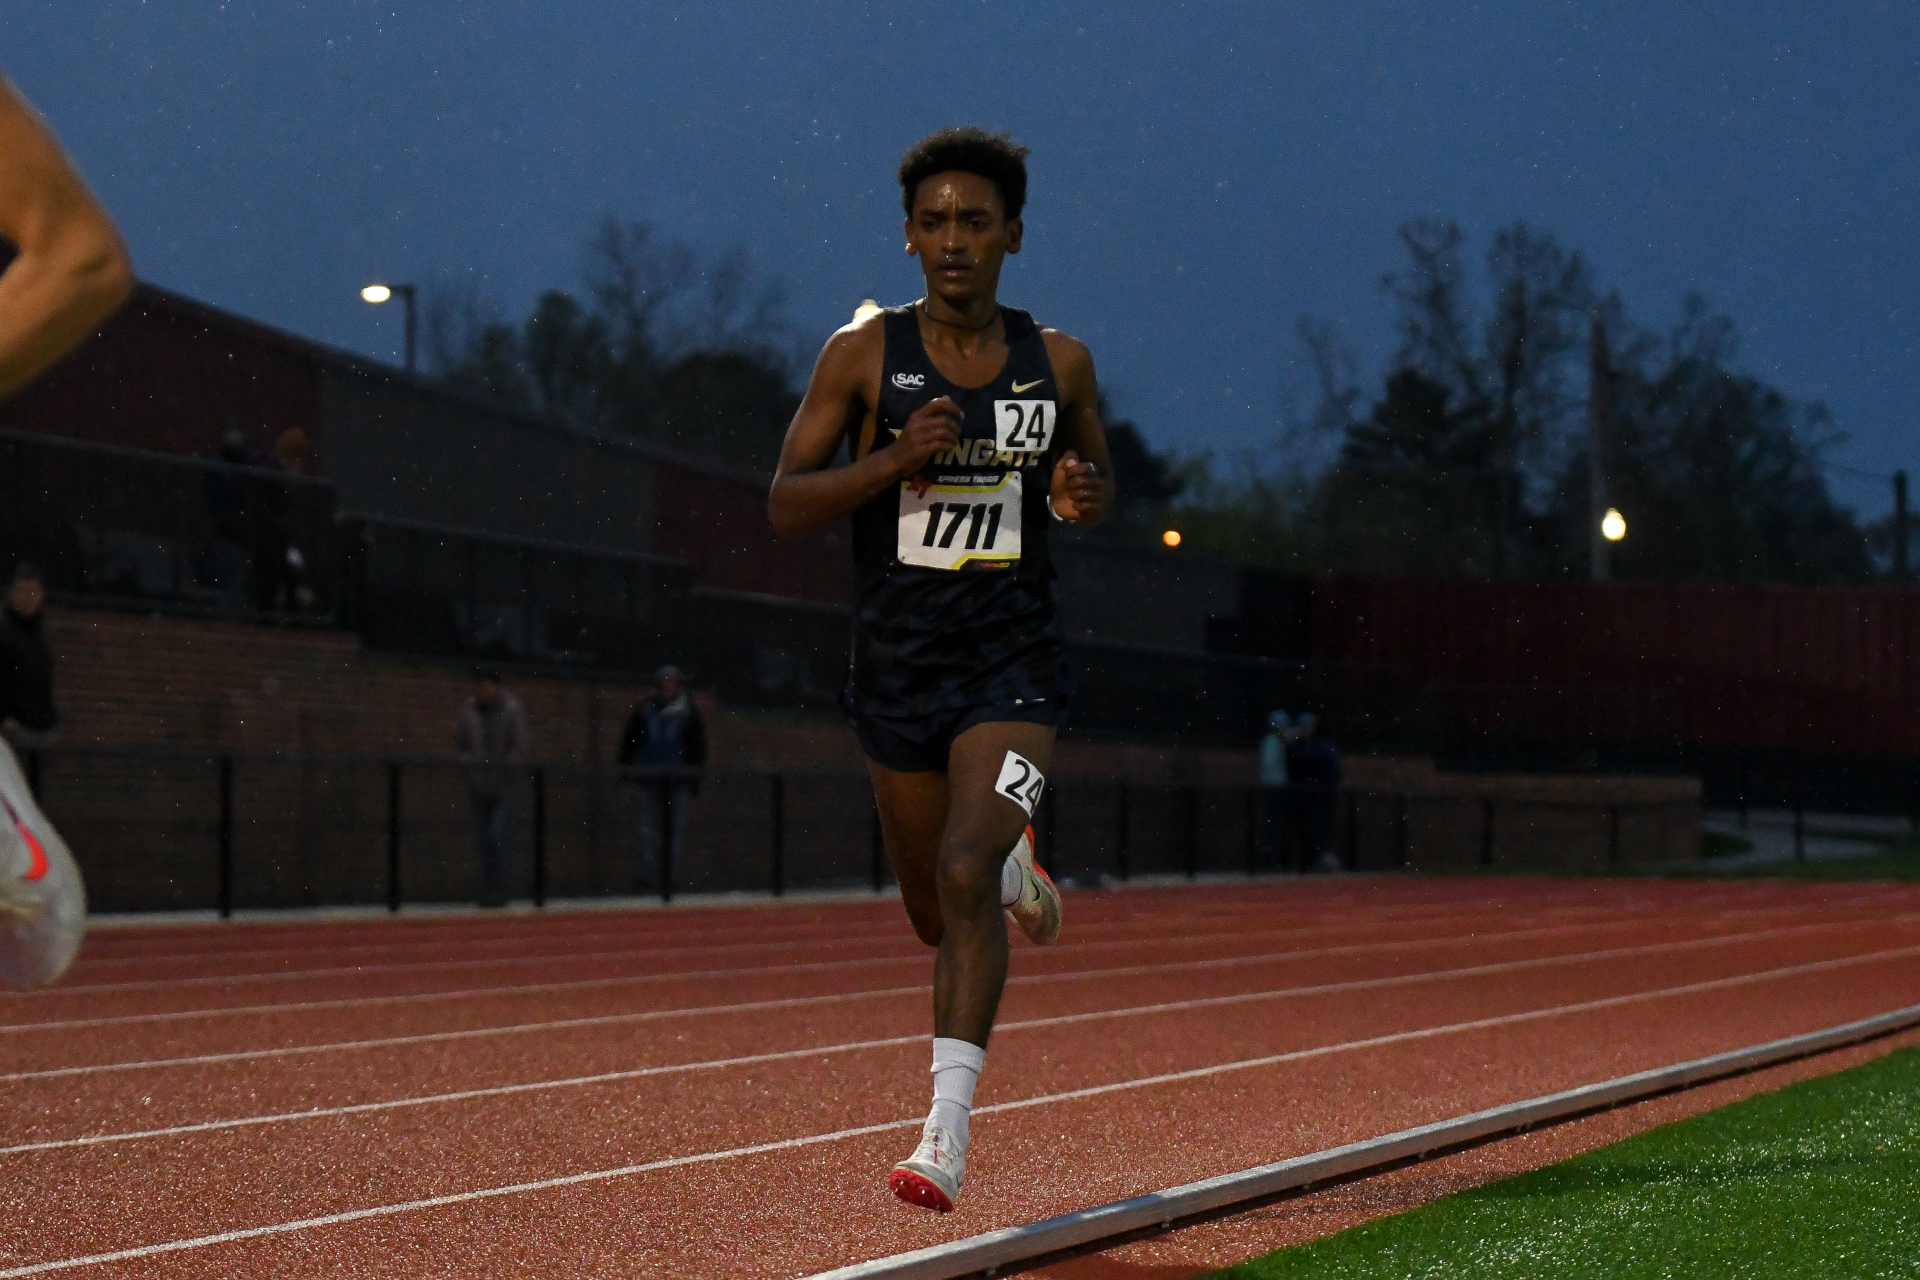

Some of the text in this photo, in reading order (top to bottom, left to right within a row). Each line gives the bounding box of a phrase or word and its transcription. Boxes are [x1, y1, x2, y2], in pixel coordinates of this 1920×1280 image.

[896, 373, 925, 385] SAC
[888, 428, 1043, 467] INGAE
[1005, 403, 1046, 448] 24
[922, 502, 1003, 549] 1711
[1004, 759, 1043, 812] 24
